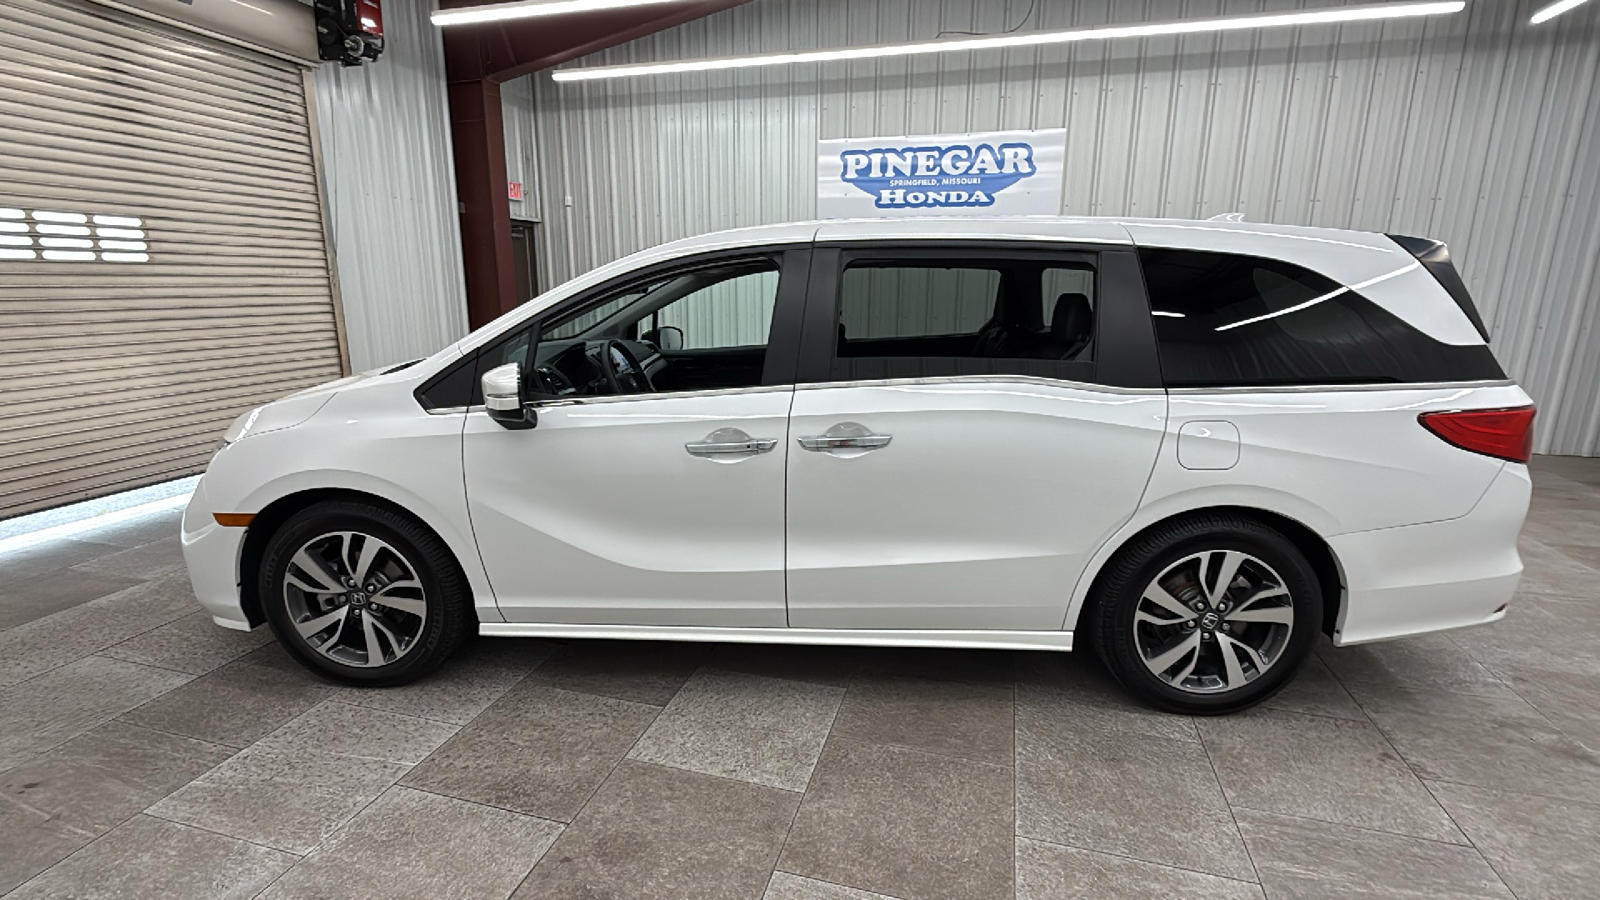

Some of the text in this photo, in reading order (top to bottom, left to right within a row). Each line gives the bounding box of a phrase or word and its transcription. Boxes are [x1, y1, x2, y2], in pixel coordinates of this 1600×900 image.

[844, 147, 1033, 179] PINEGAR
[509, 181, 522, 199] EXIT
[889, 177, 981, 187] SPRINGFIELD, MISSOURI
[879, 189, 991, 205] HONDA
